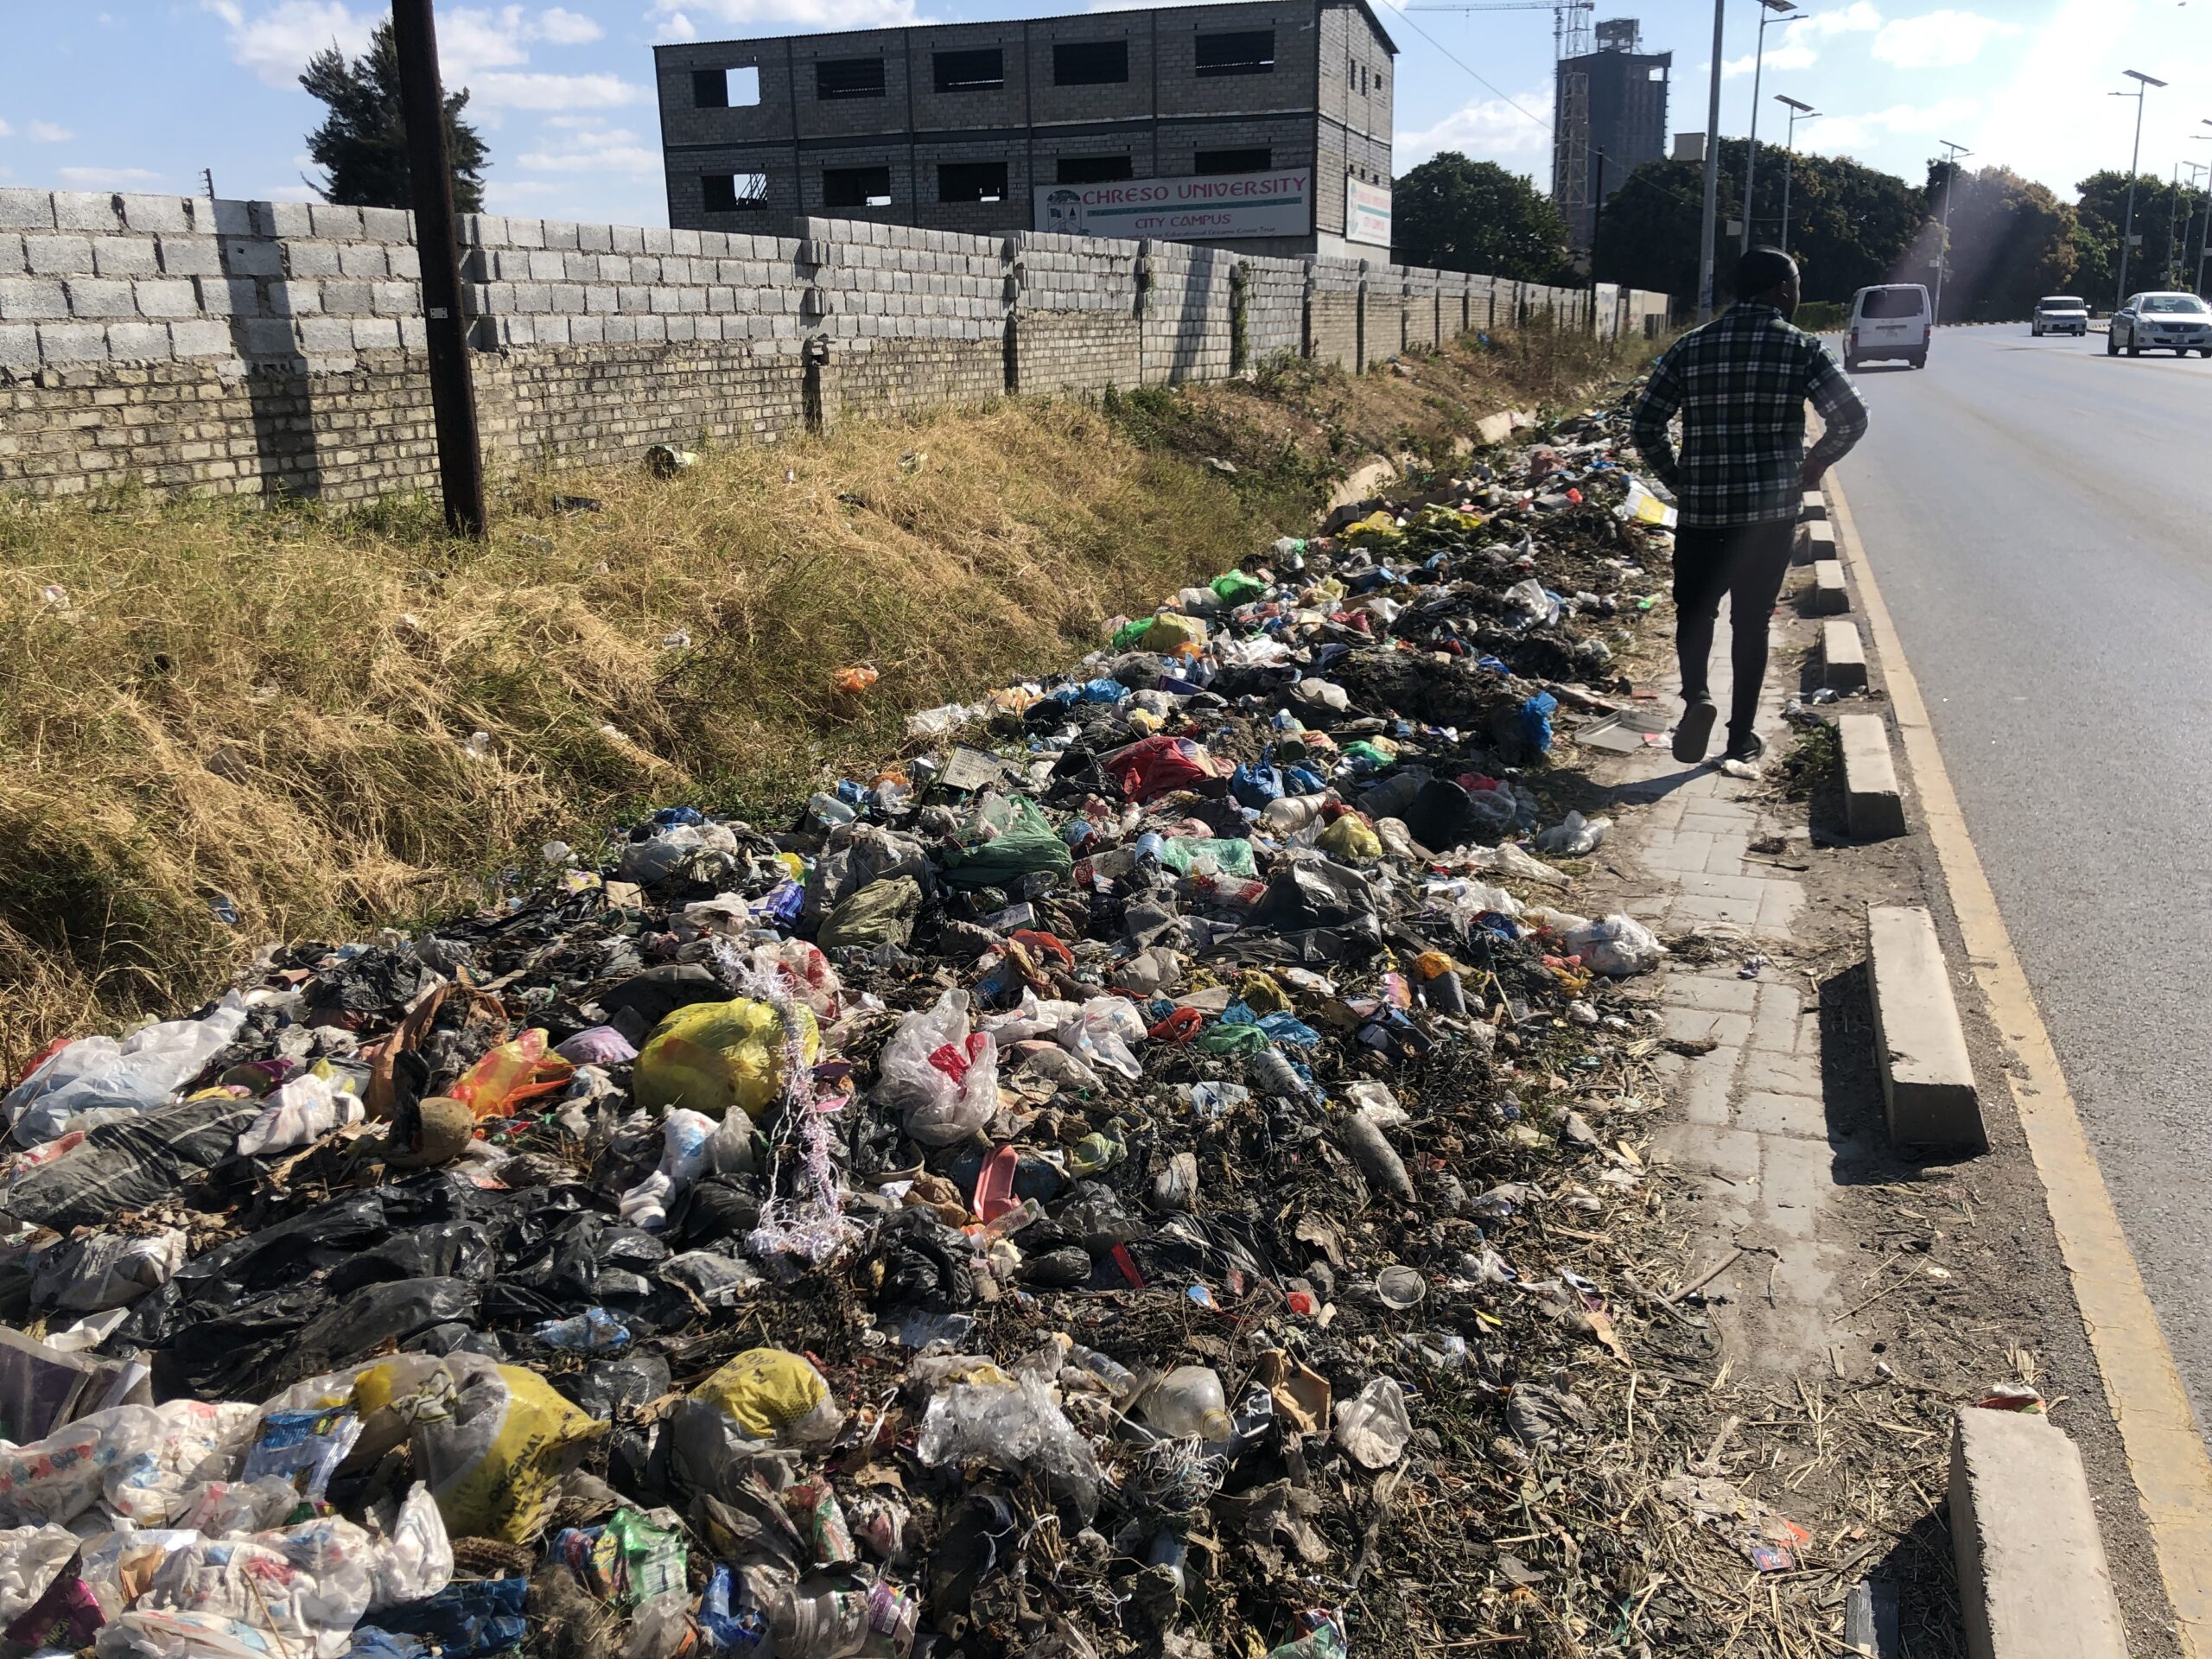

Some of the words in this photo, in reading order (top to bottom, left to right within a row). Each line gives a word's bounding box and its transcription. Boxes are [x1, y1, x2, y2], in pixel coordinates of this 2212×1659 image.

[1083, 186, 1169, 206] CHRESO
[1178, 176, 1307, 200] UNIVERSITY
[1135, 217, 1166, 229] CITY
[1170, 213, 1231, 227] CAMPUS
[489, 1433, 546, 1504] ORIGINAL
